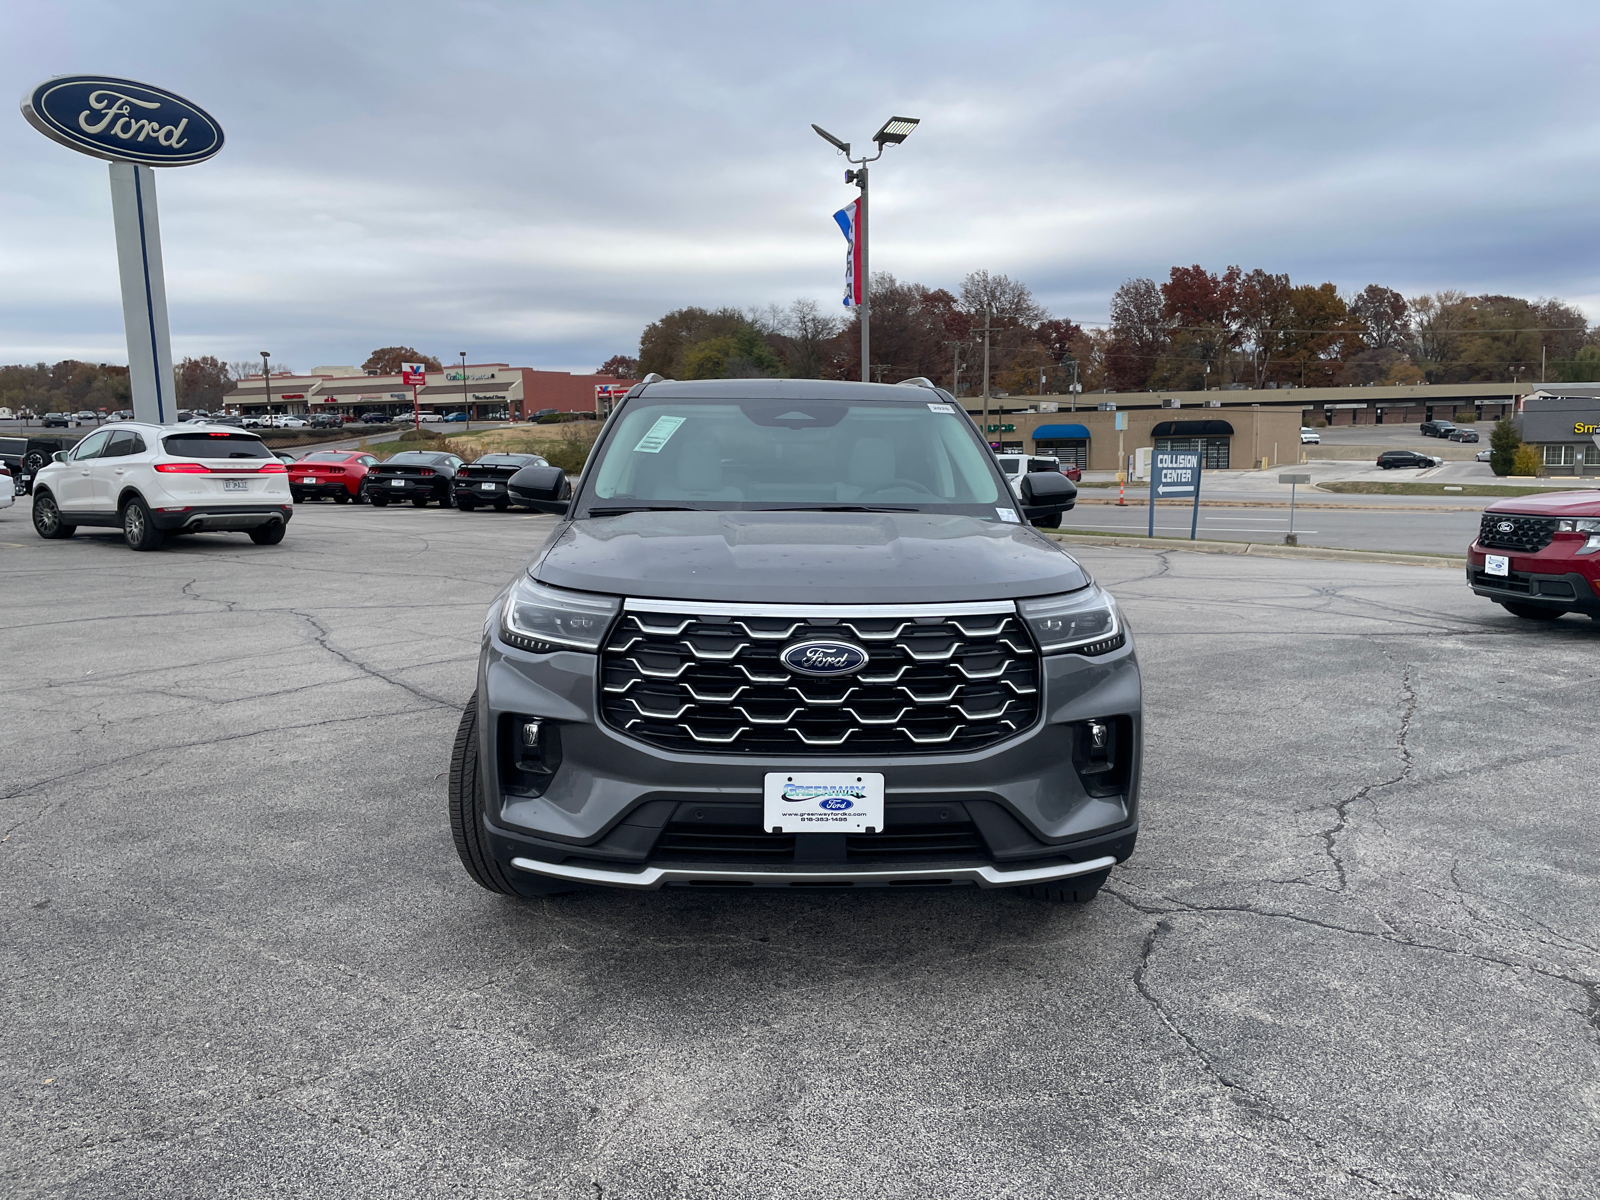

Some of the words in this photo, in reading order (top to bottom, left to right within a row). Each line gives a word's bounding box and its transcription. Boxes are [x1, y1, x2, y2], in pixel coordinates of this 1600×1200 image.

[78, 90, 189, 149] Ford
[1157, 454, 1198, 468] COLLISION
[1161, 469, 1192, 482] CENTER
[802, 648, 848, 668] Ford
[783, 784, 866, 796] GREENWAY
[826, 800, 847, 809] Ford
